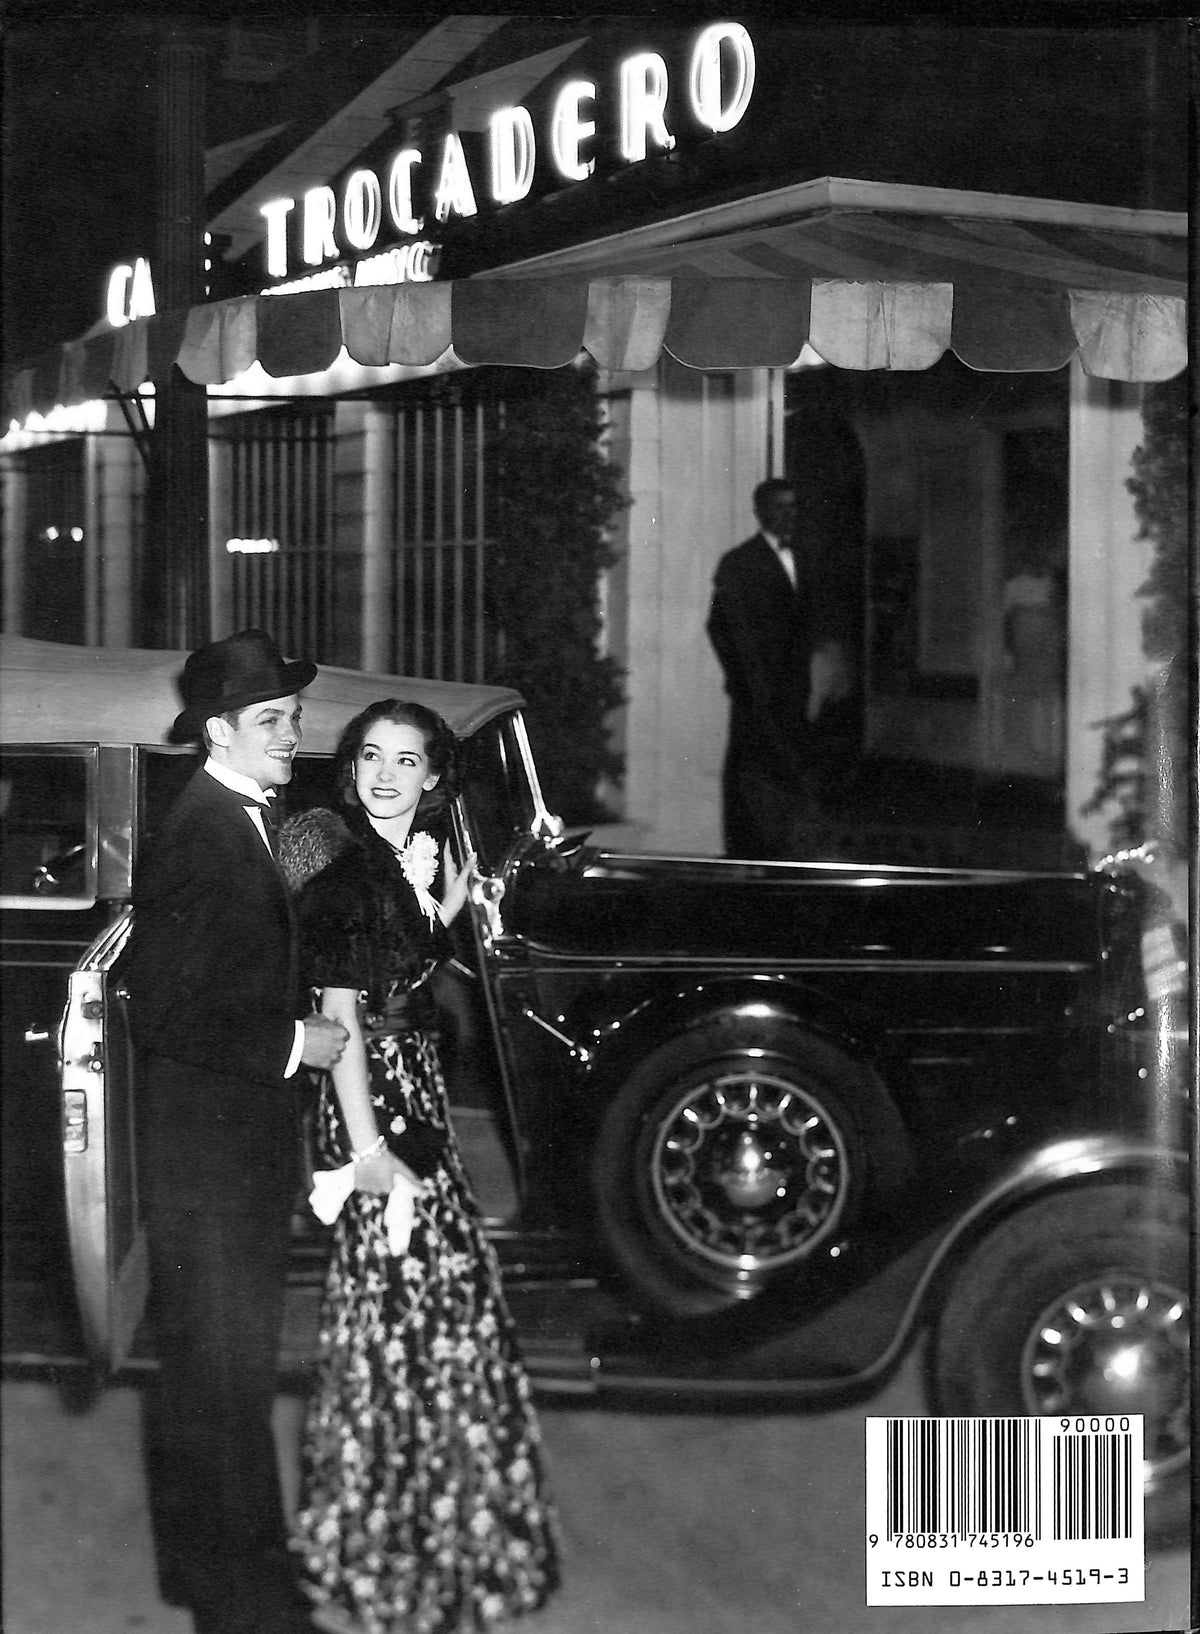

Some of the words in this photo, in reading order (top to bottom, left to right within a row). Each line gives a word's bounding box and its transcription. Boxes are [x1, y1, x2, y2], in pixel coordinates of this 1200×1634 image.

[260, 22, 756, 278] TROCADERO
[1060, 1416, 1130, 1433] 90000
[869, 1533, 879, 1549] 9
[881, 1570, 933, 1588] ISBN
[949, 1567, 1129, 1587] 0-8317-4519-3
